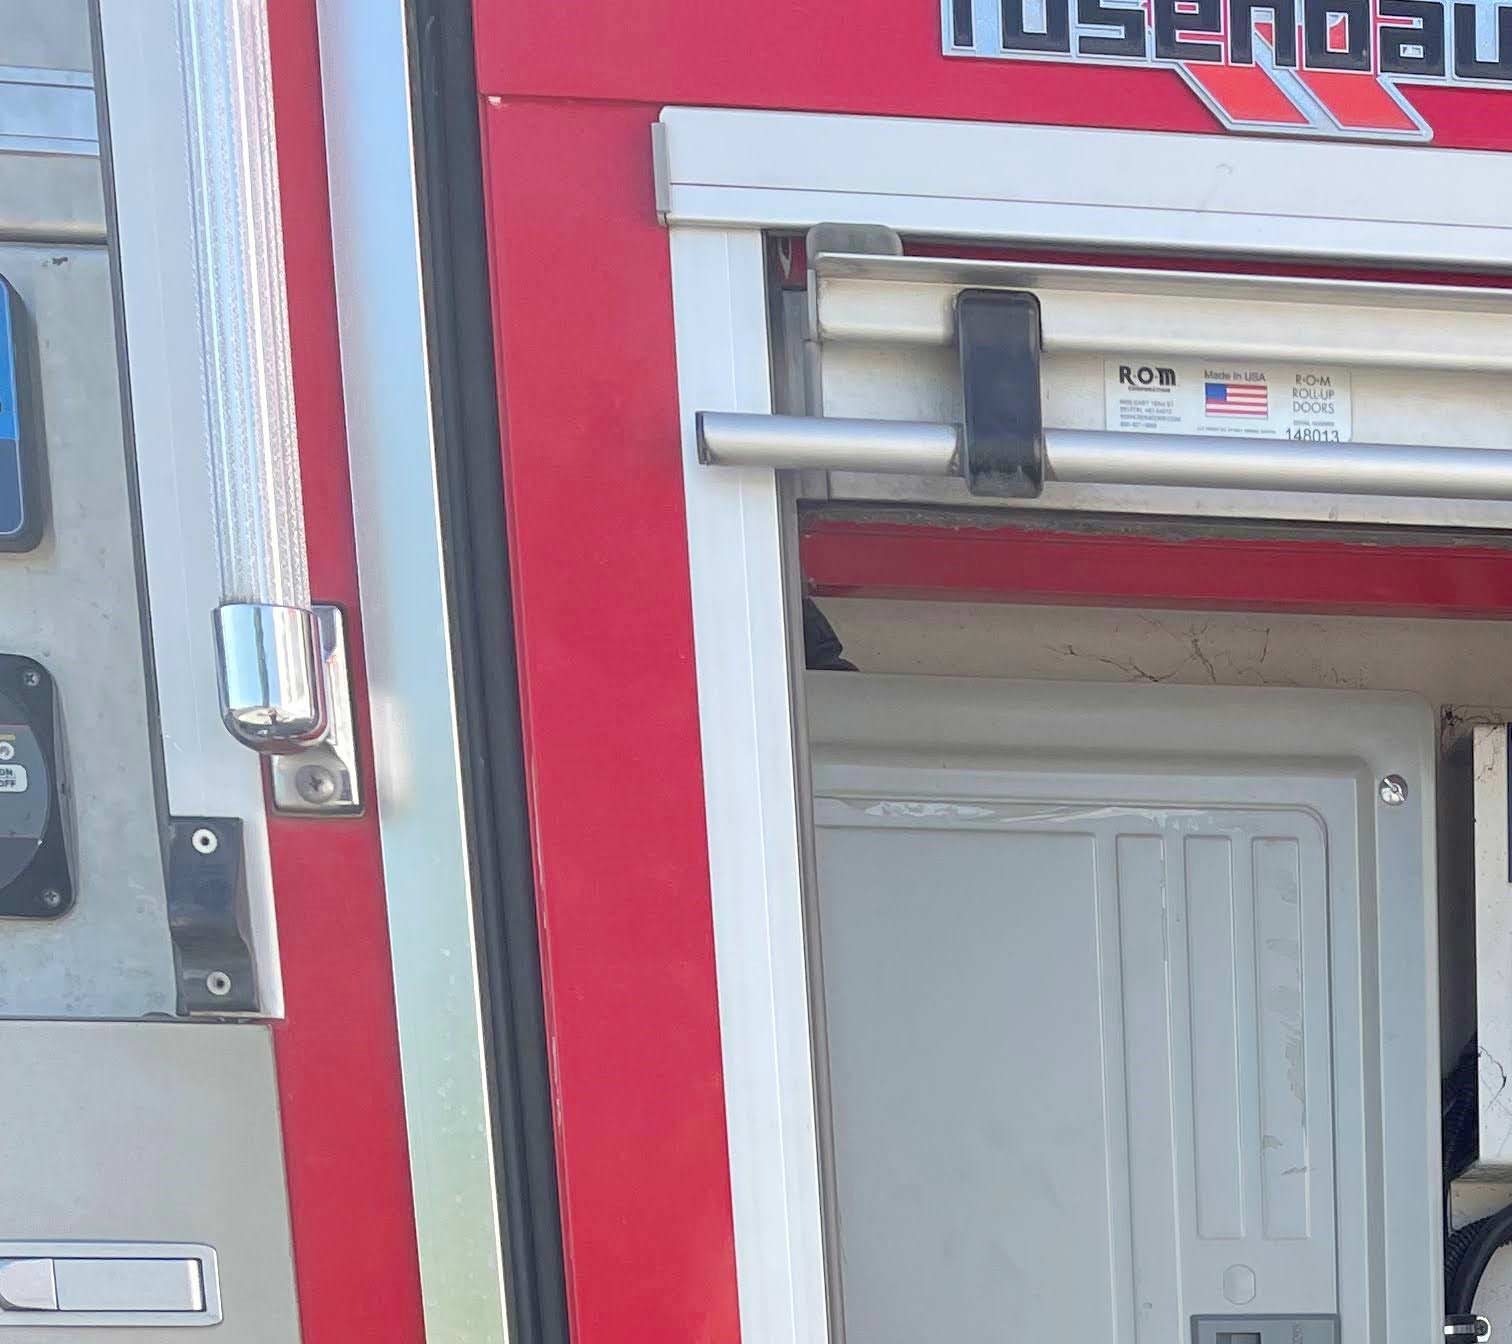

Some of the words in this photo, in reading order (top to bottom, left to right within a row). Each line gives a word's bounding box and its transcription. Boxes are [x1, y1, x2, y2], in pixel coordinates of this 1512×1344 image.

[1204, 370, 1231, 380] Made
[1244, 371, 1266, 382] USA
[1293, 401, 1335, 414] DOORS
[1285, 427, 1340, 443] 148013
